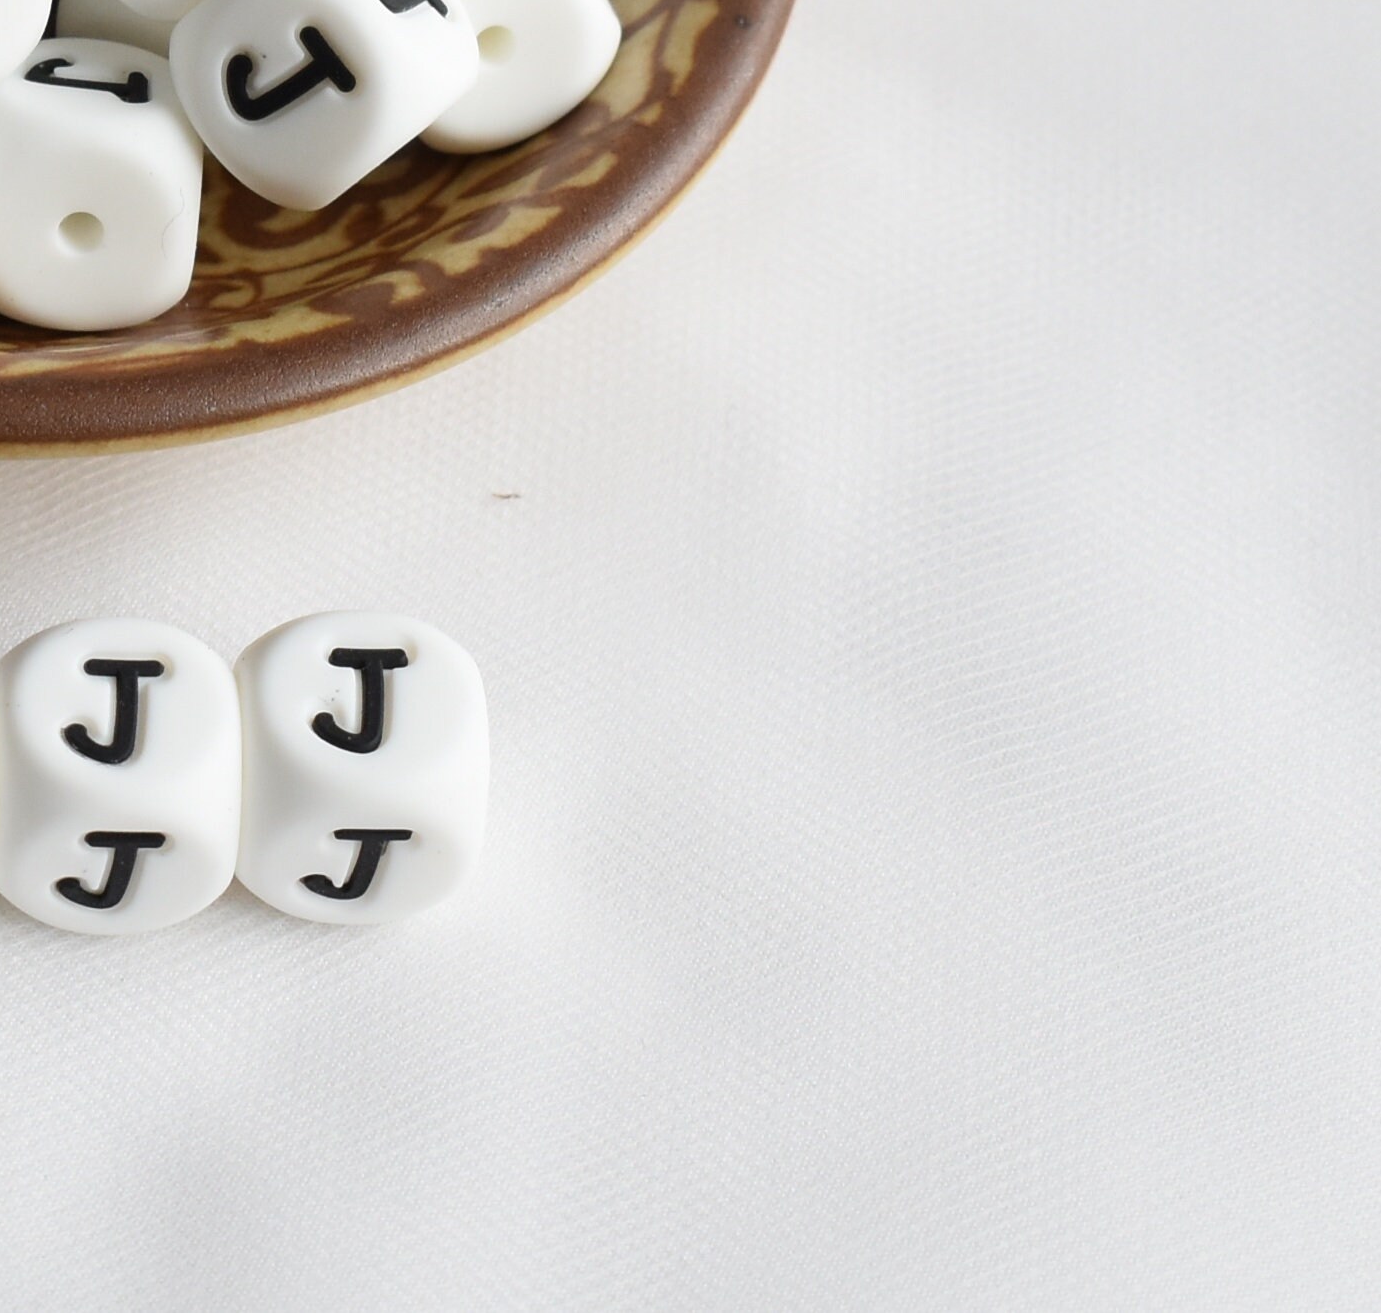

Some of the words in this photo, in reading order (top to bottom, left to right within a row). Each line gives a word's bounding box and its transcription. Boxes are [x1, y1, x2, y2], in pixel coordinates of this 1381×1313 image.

[23, 57, 150, 104] J
[224, 24, 358, 123] J
[63, 658, 166, 766] J
[310, 647, 410, 755] J
[55, 830, 167, 910] J
[300, 827, 414, 901] J
